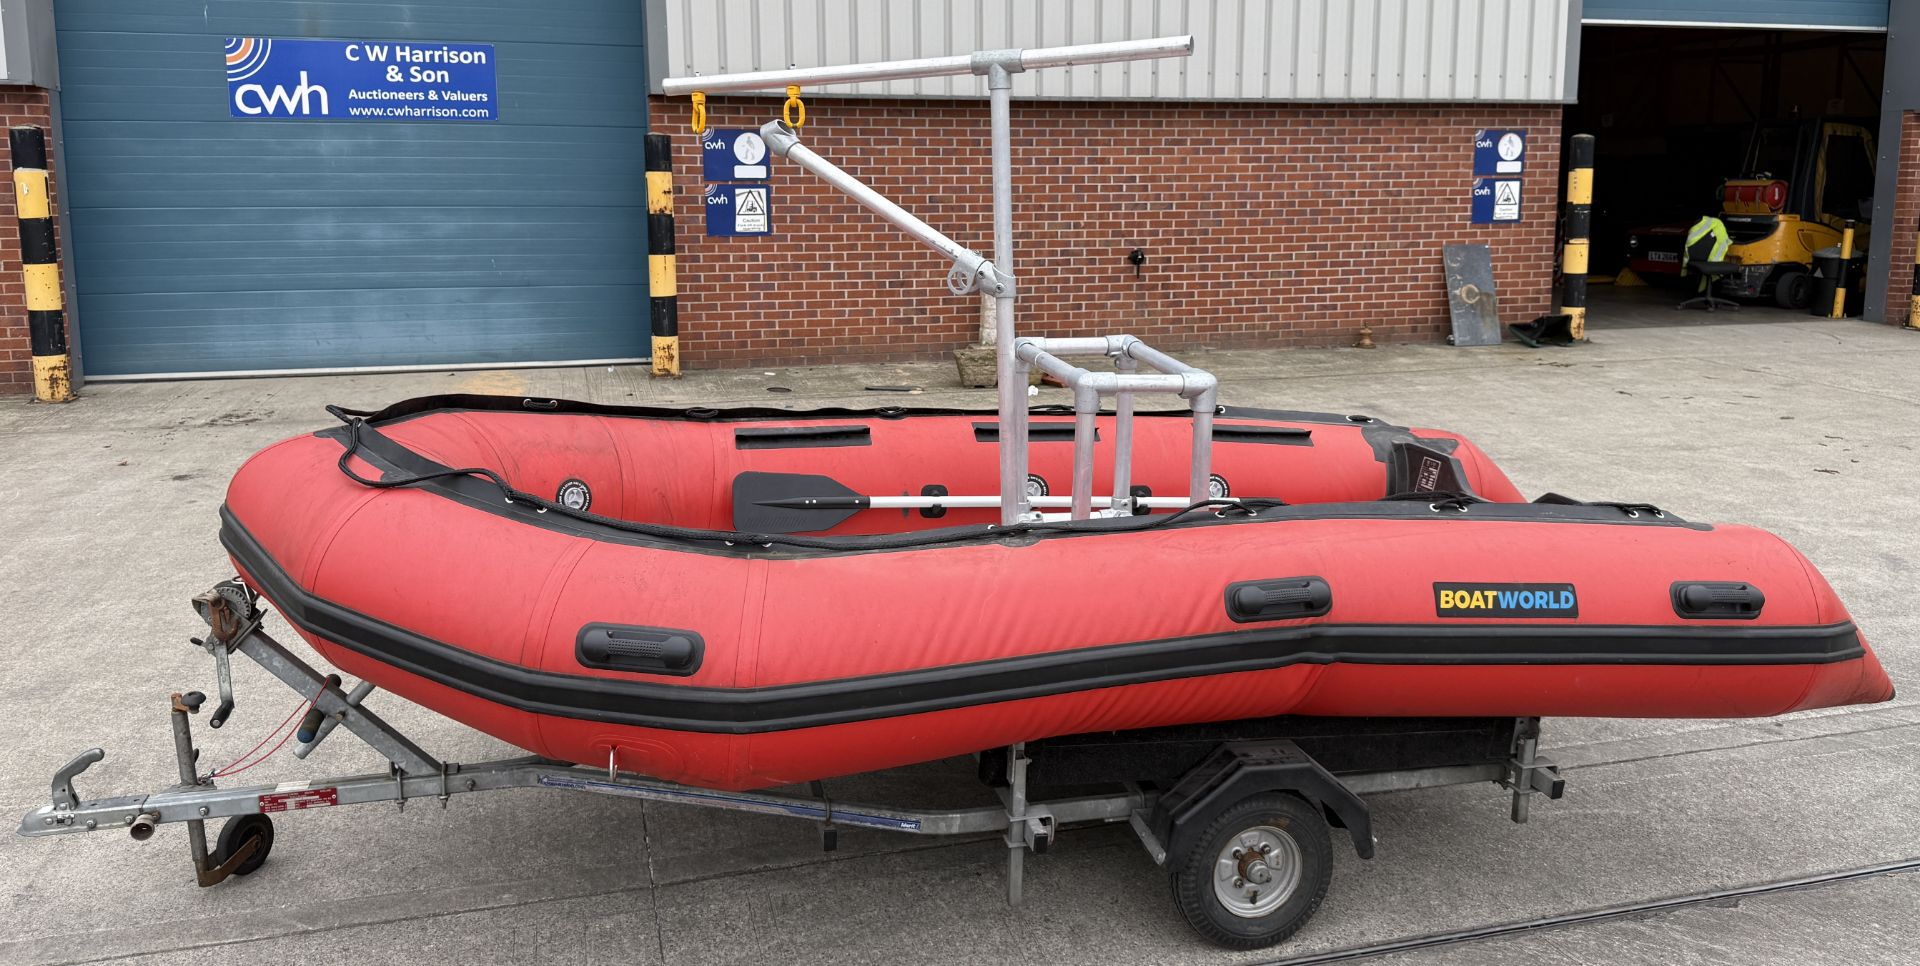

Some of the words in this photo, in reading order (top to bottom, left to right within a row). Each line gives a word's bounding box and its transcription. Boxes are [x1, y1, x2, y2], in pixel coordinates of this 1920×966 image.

[345, 44, 359, 62] C
[365, 45, 388, 62] W
[396, 46, 486, 64] Harrison
[386, 65, 403, 82] &
[410, 66, 449, 83] Son
[235, 70, 329, 115] cwh
[348, 89, 425, 100] Auctioneers
[428, 89, 438, 100] &
[441, 90, 488, 102] Valuers
[349, 105, 489, 118] www.cwharrison.com
[704, 138, 726, 150] cwh
[1476, 138, 1493, 149] cwh
[1474, 186, 1491, 196] cwh
[707, 193, 728, 205] cwh
[1439, 590, 1574, 609] BOATWORLD
